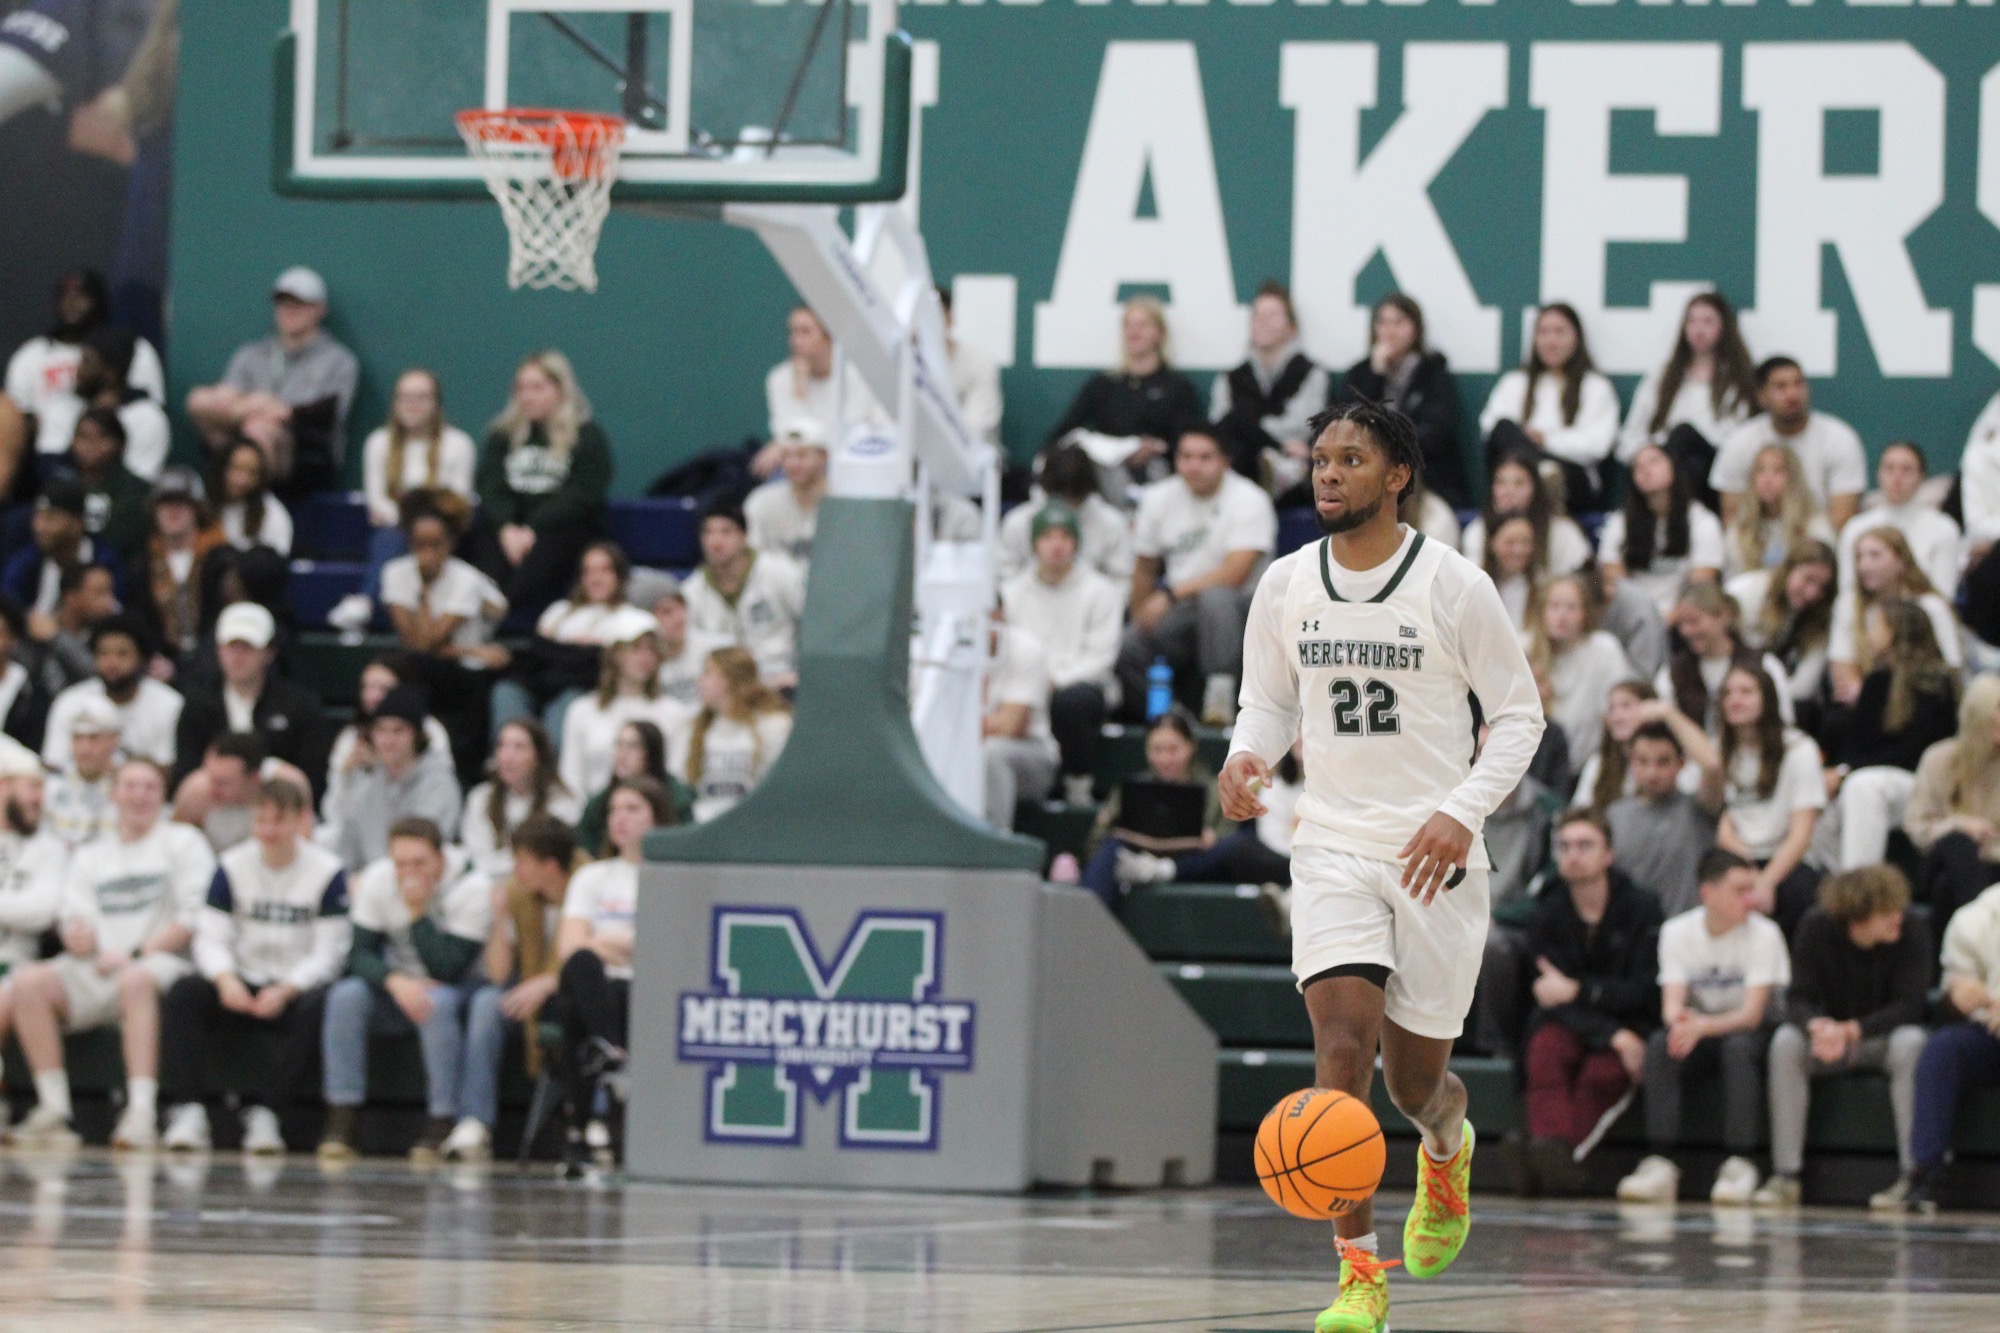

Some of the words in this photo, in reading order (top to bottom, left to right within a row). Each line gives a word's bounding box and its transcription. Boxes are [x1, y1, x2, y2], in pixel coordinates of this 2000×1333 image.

[847, 40, 2000, 378] AKER
[1298, 640, 1424, 671] MERCYHURST
[1328, 677, 1400, 736] 22
[682, 997, 970, 1051] MERCYHURST
